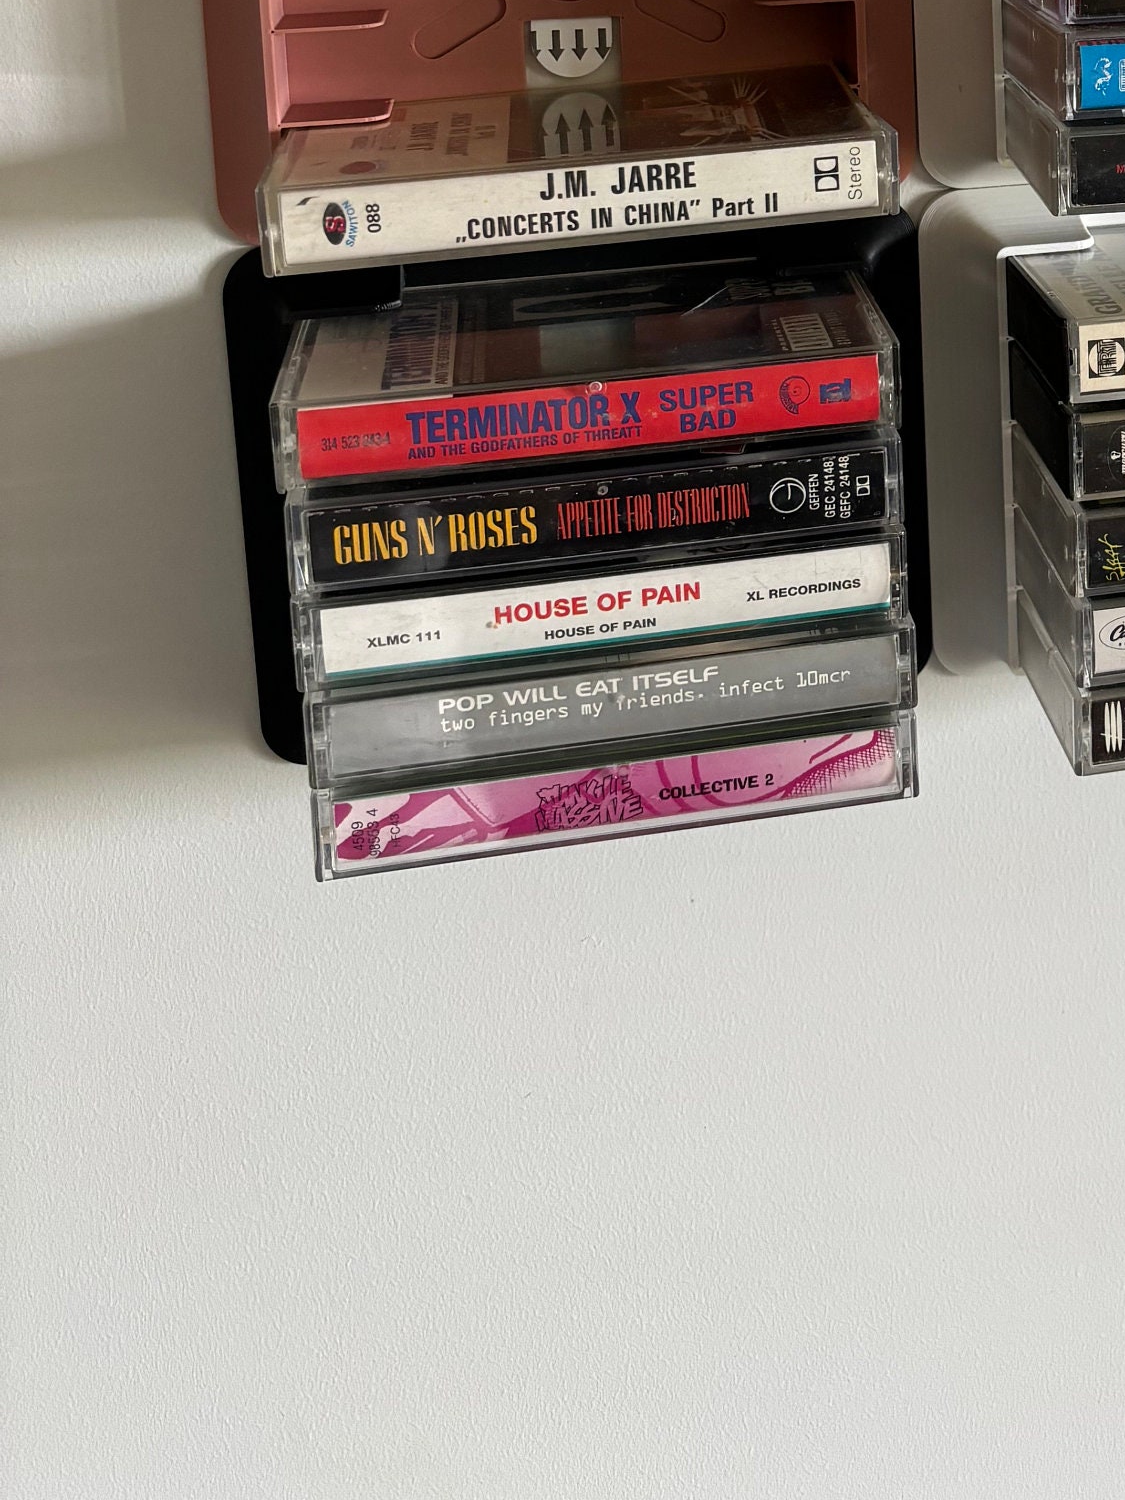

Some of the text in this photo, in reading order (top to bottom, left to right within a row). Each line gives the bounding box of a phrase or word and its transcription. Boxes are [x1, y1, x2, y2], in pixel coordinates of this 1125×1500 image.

[539, 161, 697, 200] J.M. JARRE
[848, 146, 862, 200] Stereo
[591, 207, 613, 229] IN
[712, 197, 754, 218] Part
[765, 192, 778, 213] II
[659, 381, 754, 412] SUPER
[405, 392, 642, 445] TERMINATOR X
[680, 408, 736, 433] BAD
[408, 426, 642, 460] AND THE GODFATHERS OF THREATT
[626, 482, 750, 532] FOR DESTRUCTION
[809, 473, 819, 511] GEFFEN
[823, 461, 836, 519] GEC 24148
[839, 455, 851, 520] GEFC 24148
[333, 506, 538, 565] GUNS ROSES
[495, 581, 700, 625] HOUSE OF PAIN
[747, 578, 861, 602] XL RECORDINGS
[367, 630, 441, 649] XLMC 111
[544, 618, 657, 640] HOUSE OF PAIN
[438, 666, 718, 715] POP WILL EAT ITSELF
[441, 677, 785, 733] two fingers my infect
[658, 774, 774, 801] COLLECTIVE 2
